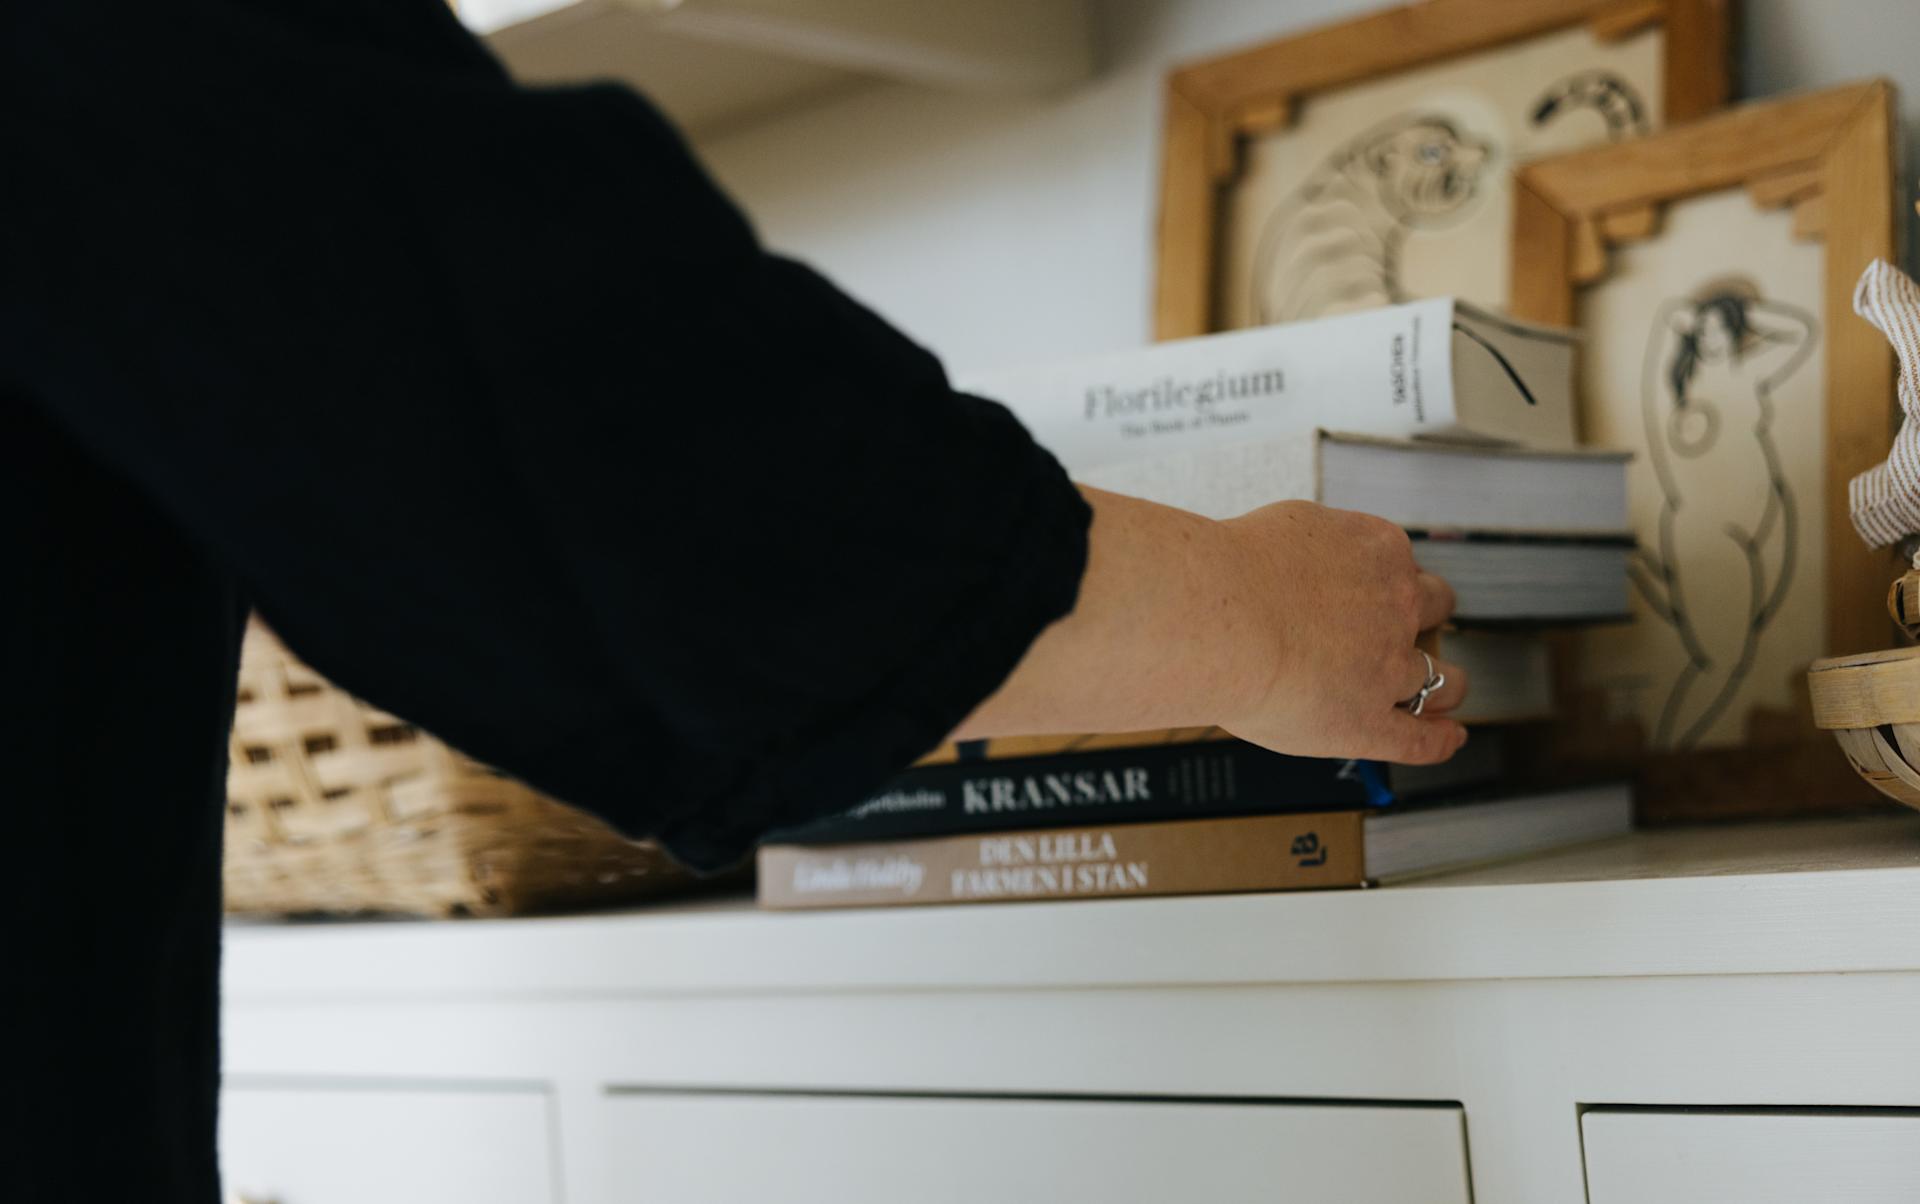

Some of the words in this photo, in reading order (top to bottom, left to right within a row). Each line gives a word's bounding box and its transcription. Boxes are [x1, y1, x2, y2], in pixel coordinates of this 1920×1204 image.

[1084, 367, 1285, 421] Florilegium
[963, 768, 1151, 814] KRANSAR
[979, 836, 1036, 866] DEN
[1039, 832, 1118, 862] LILLA
[952, 867, 1058, 897] FARMEN
[1077, 862, 1148, 891] STAN
